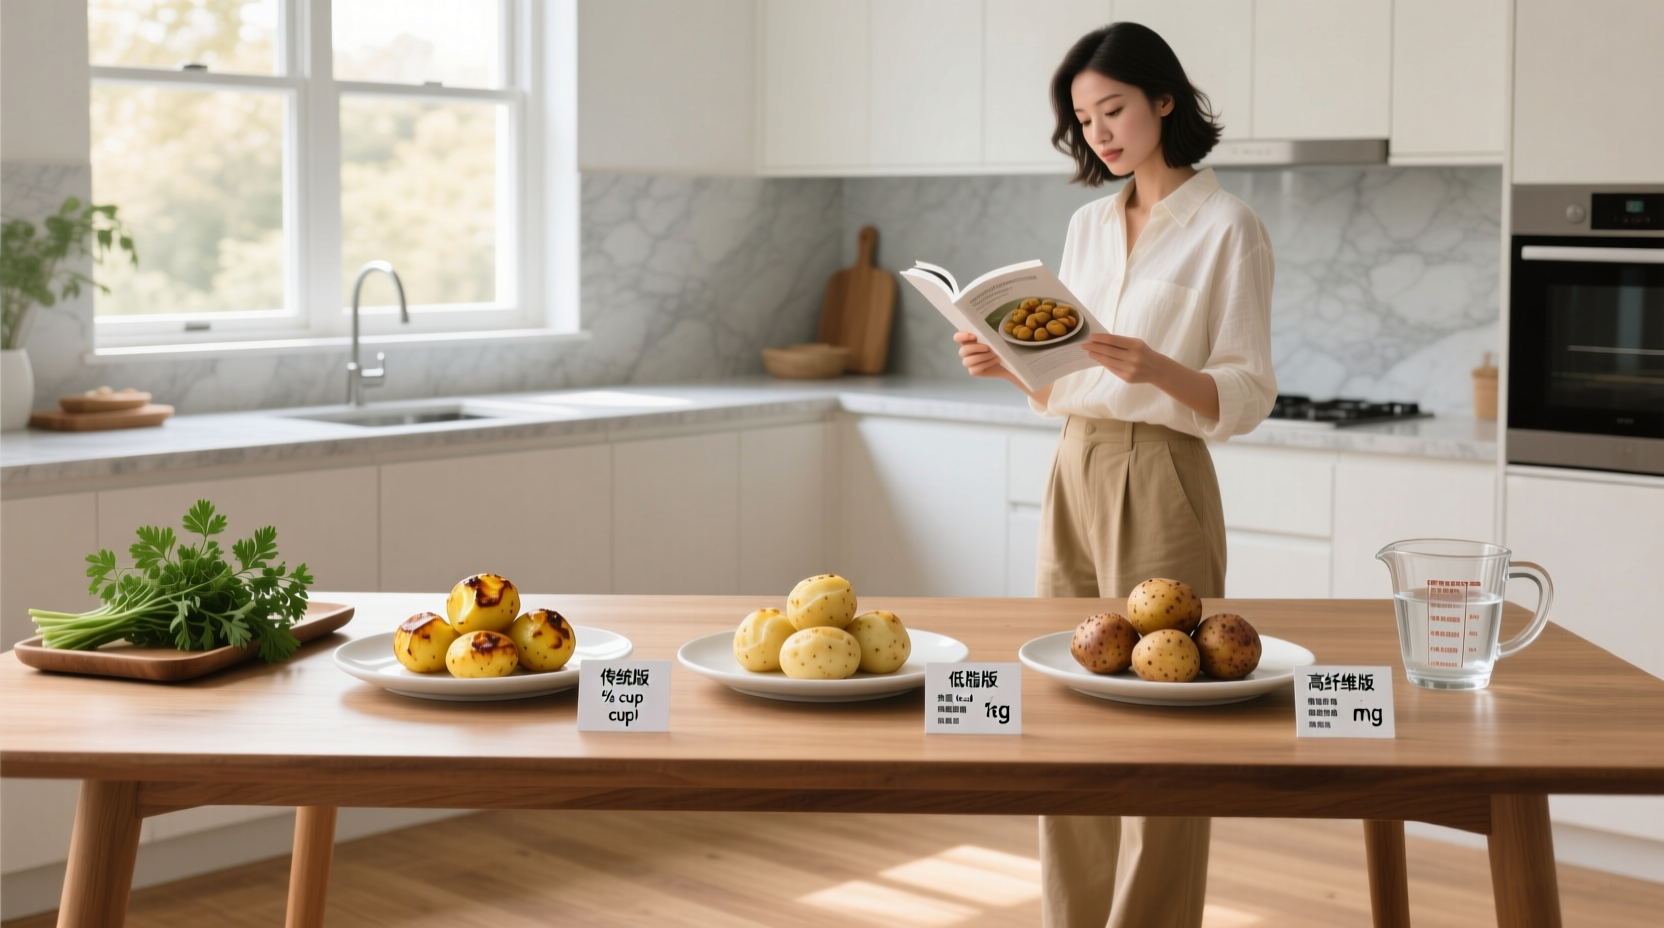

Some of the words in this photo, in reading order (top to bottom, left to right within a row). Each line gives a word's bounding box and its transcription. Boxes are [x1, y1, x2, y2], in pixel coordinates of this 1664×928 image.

[601, 668, 649, 686] 传统版
[1307, 672, 1375, 691] 高纤维版
[619, 694, 643, 708] cup
[1353, 708, 1383, 727] mg
